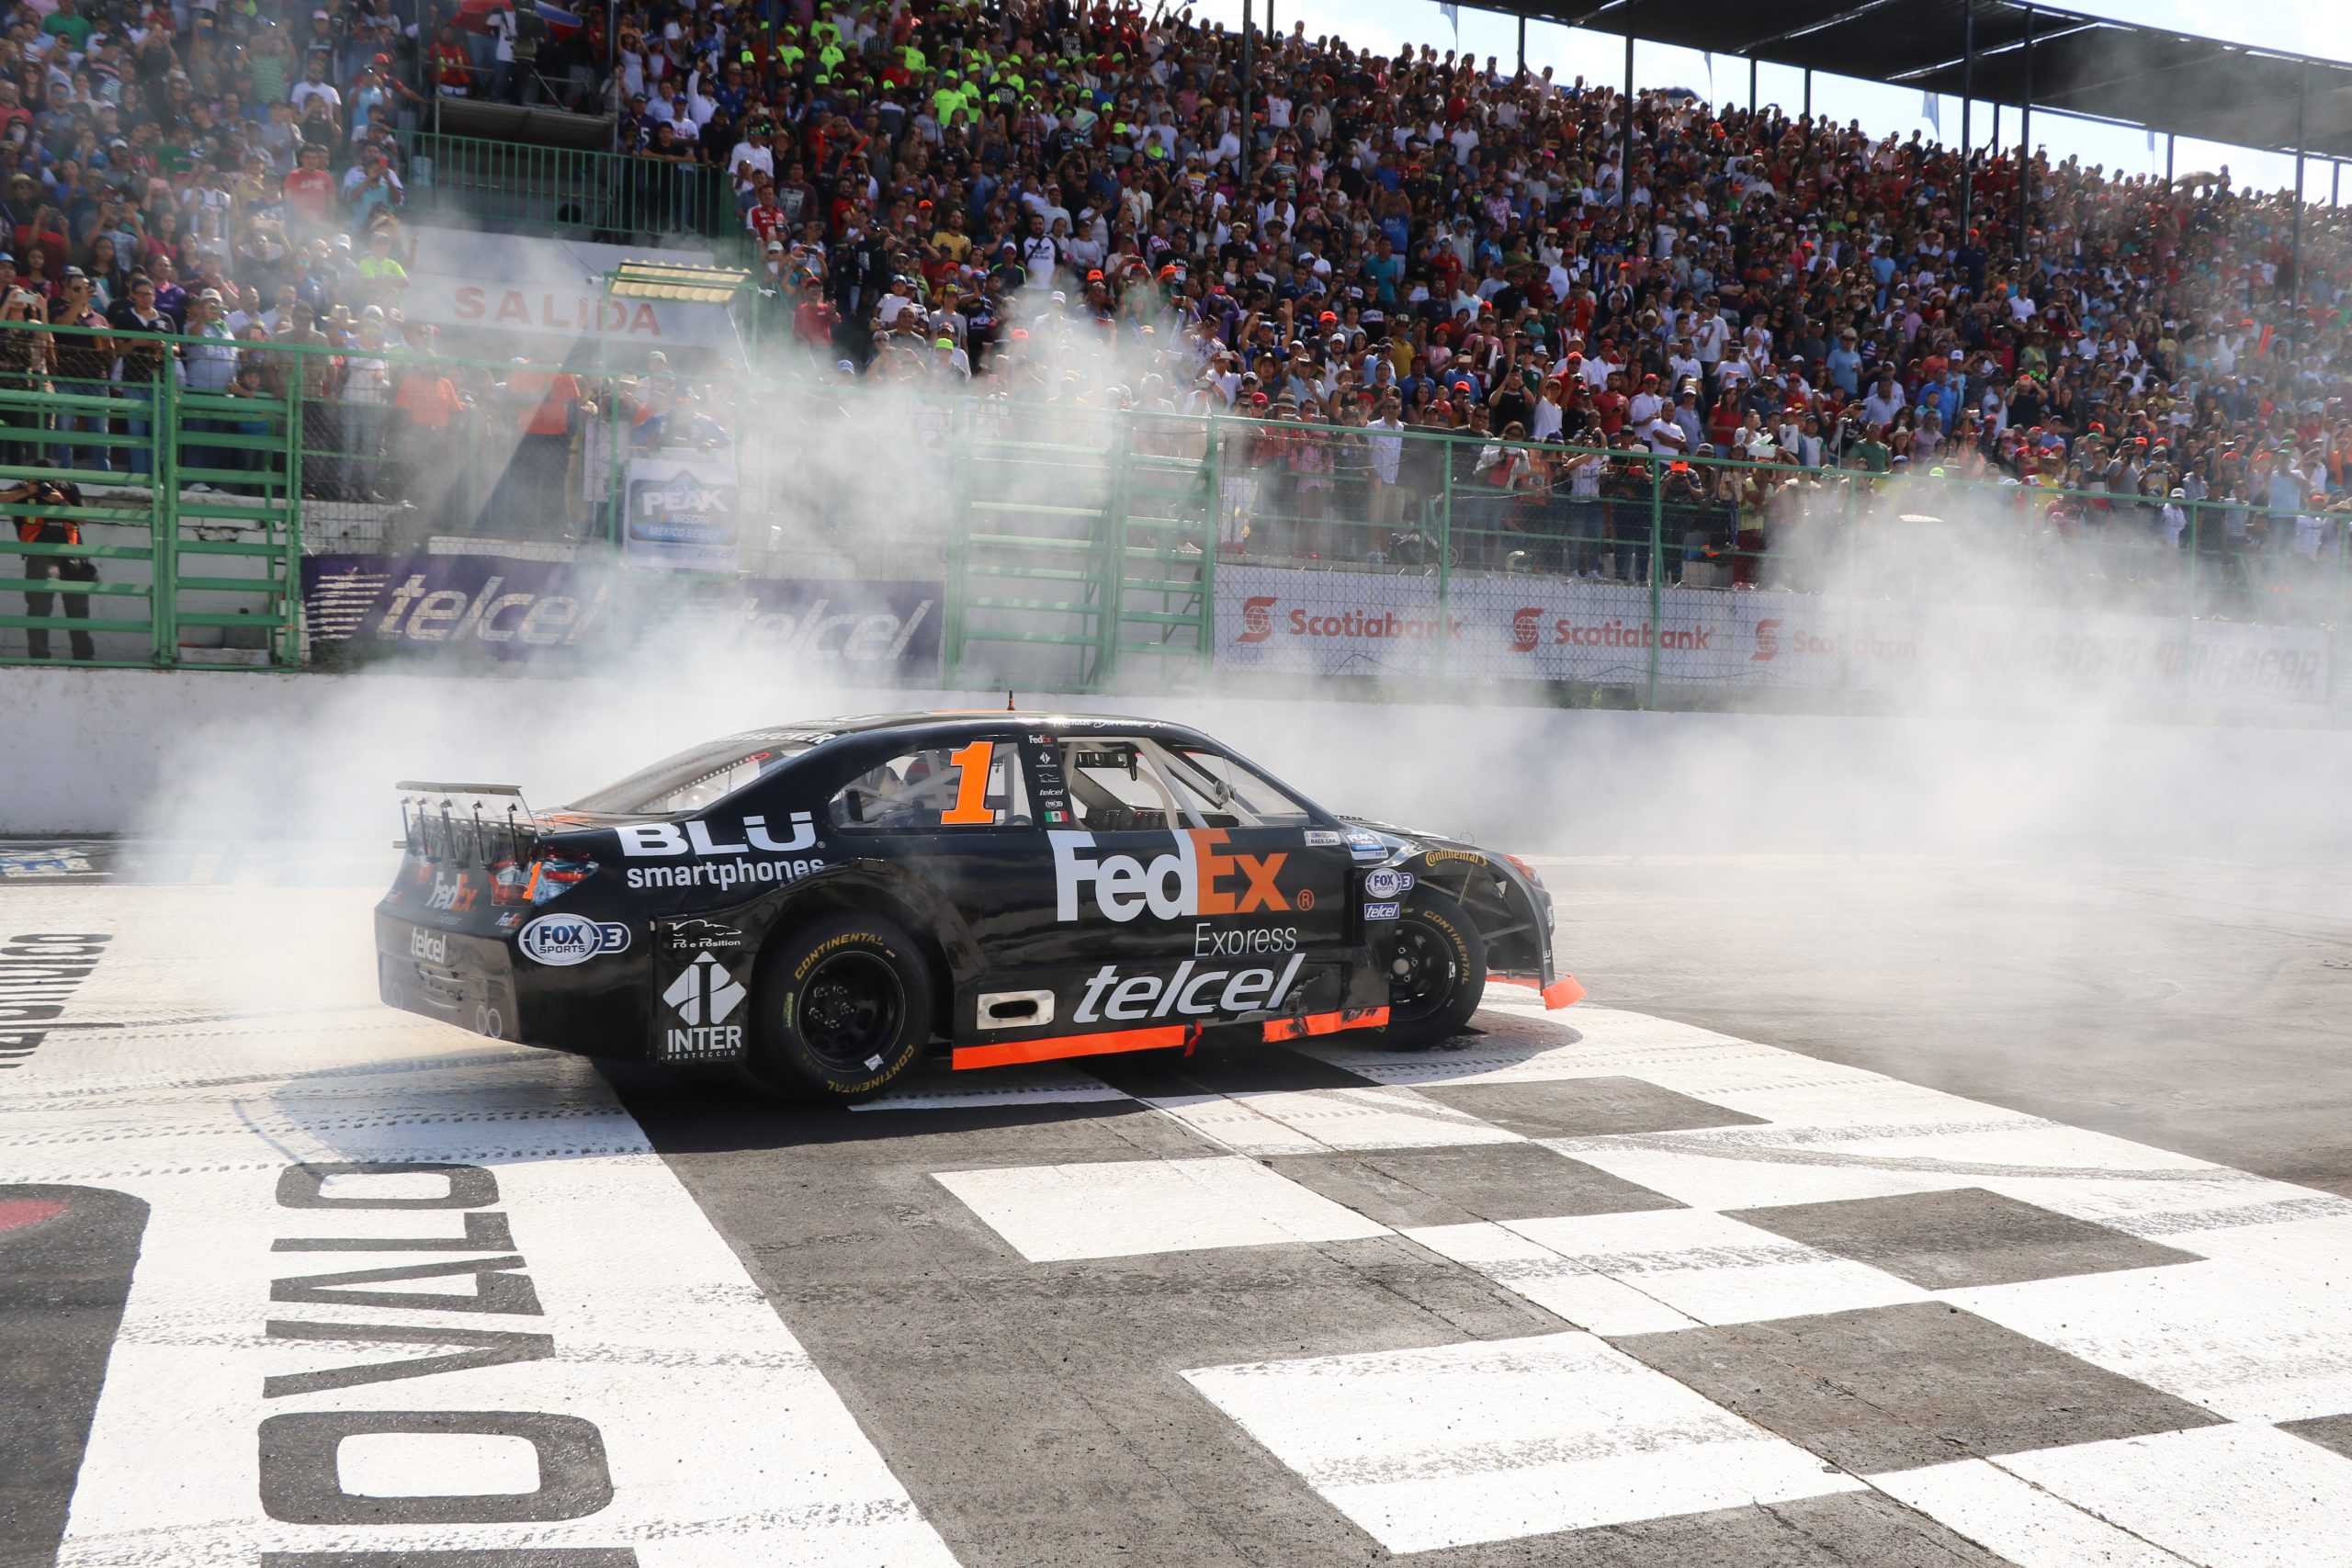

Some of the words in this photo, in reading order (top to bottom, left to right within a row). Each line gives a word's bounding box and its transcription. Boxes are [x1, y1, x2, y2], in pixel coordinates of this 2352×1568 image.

[454, 286, 662, 336] SALIDA
[643, 490, 729, 515] PEAK
[671, 514, 712, 525] NASCAR
[376, 574, 608, 645] telcel
[1289, 609, 1462, 640] Scotiabank
[729, 597, 934, 660] telcel
[941, 740, 995, 825] 1
[1039, 788, 1064, 796] telcel
[627, 857, 825, 891] smartphones
[1426, 848, 1479, 866] Continental
[522, 862, 542, 900] 1
[1046, 829, 1292, 922] FedEx
[1374, 874, 1394, 886] FOX
[1402, 874, 1411, 887] 3
[1365, 904, 1397, 919] telcel
[411, 926, 447, 964] telcel
[539, 924, 584, 945] FOX
[539, 944, 585, 954] SPORTS
[605, 928, 623, 947] 3
[1194, 922, 1297, 957] Express
[1423, 909, 1471, 985] CONTINENTAL
[794, 932, 884, 980] CONTINENTAL
[1073, 953, 1306, 1023] telcel
[667, 1025, 742, 1053] INTER
[827, 1044, 915, 1093] CONTINENTAL
